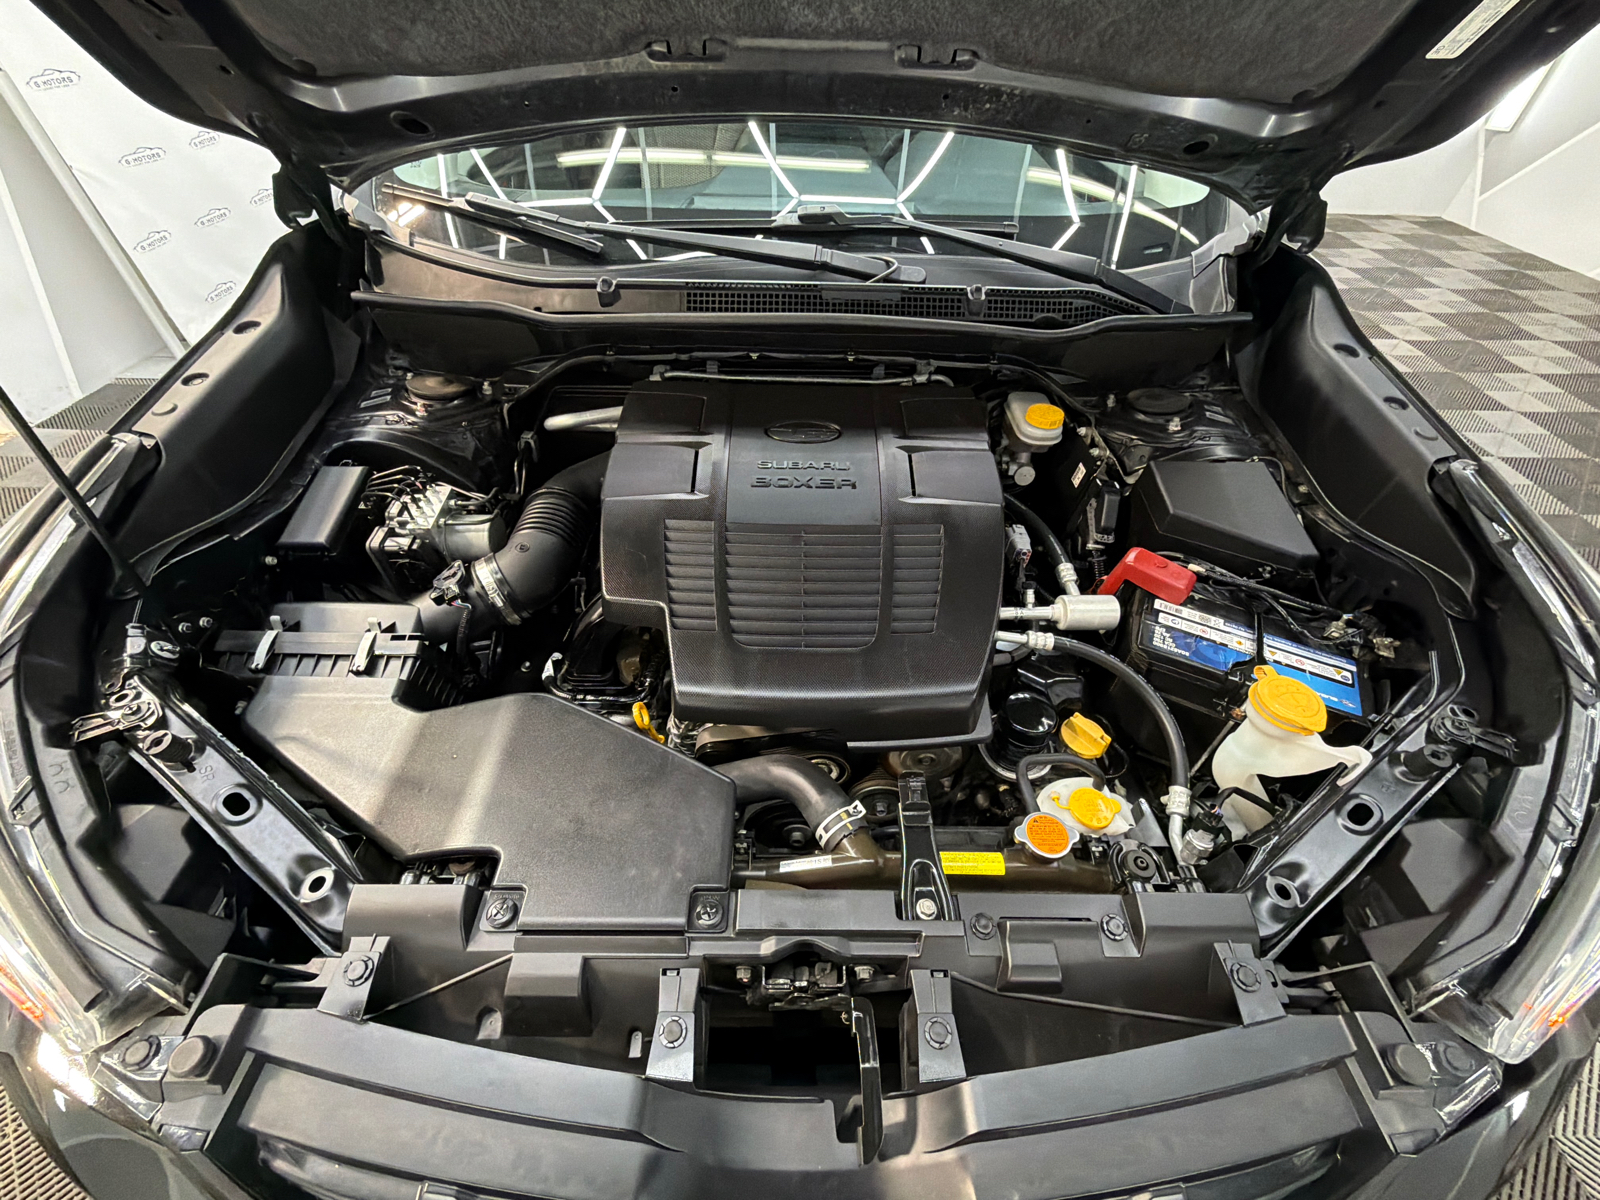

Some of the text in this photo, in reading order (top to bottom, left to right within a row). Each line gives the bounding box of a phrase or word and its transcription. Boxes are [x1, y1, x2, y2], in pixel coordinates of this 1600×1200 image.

[41, 76, 74, 87] MOTORS
[132, 152, 162, 164] MOTORS
[757, 460, 851, 471] SUBARU
[750, 475, 857, 489] BOXER
